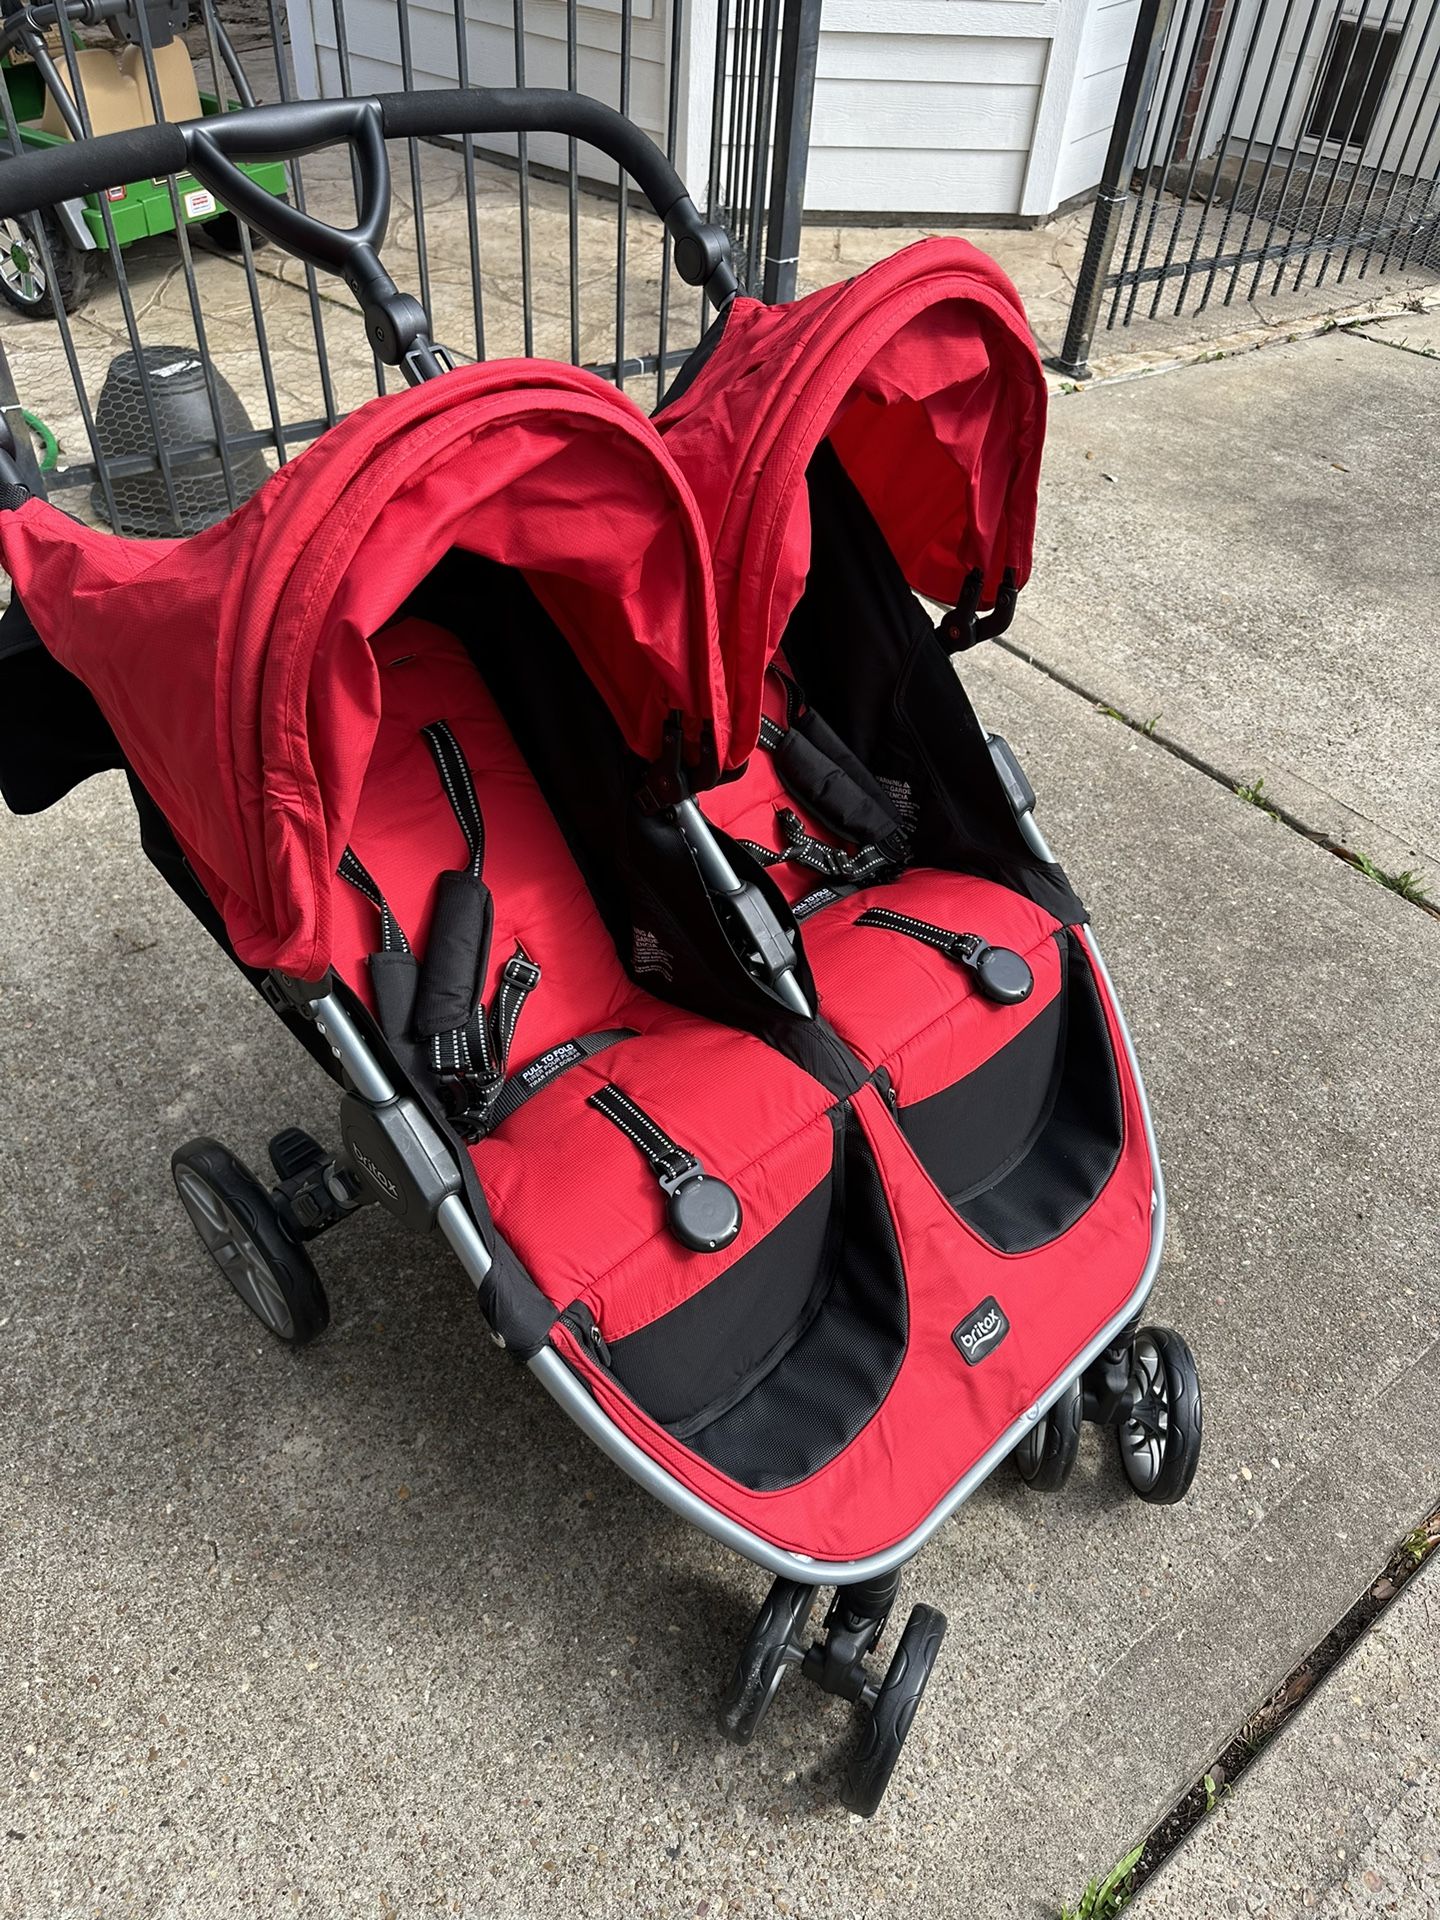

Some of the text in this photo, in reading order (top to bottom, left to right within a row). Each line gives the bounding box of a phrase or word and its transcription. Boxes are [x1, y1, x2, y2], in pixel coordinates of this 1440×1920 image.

[522, 1044, 574, 1080] PULL TO FOLD
[352, 1142, 399, 1197] britax
[960, 1308, 999, 1348] britax
